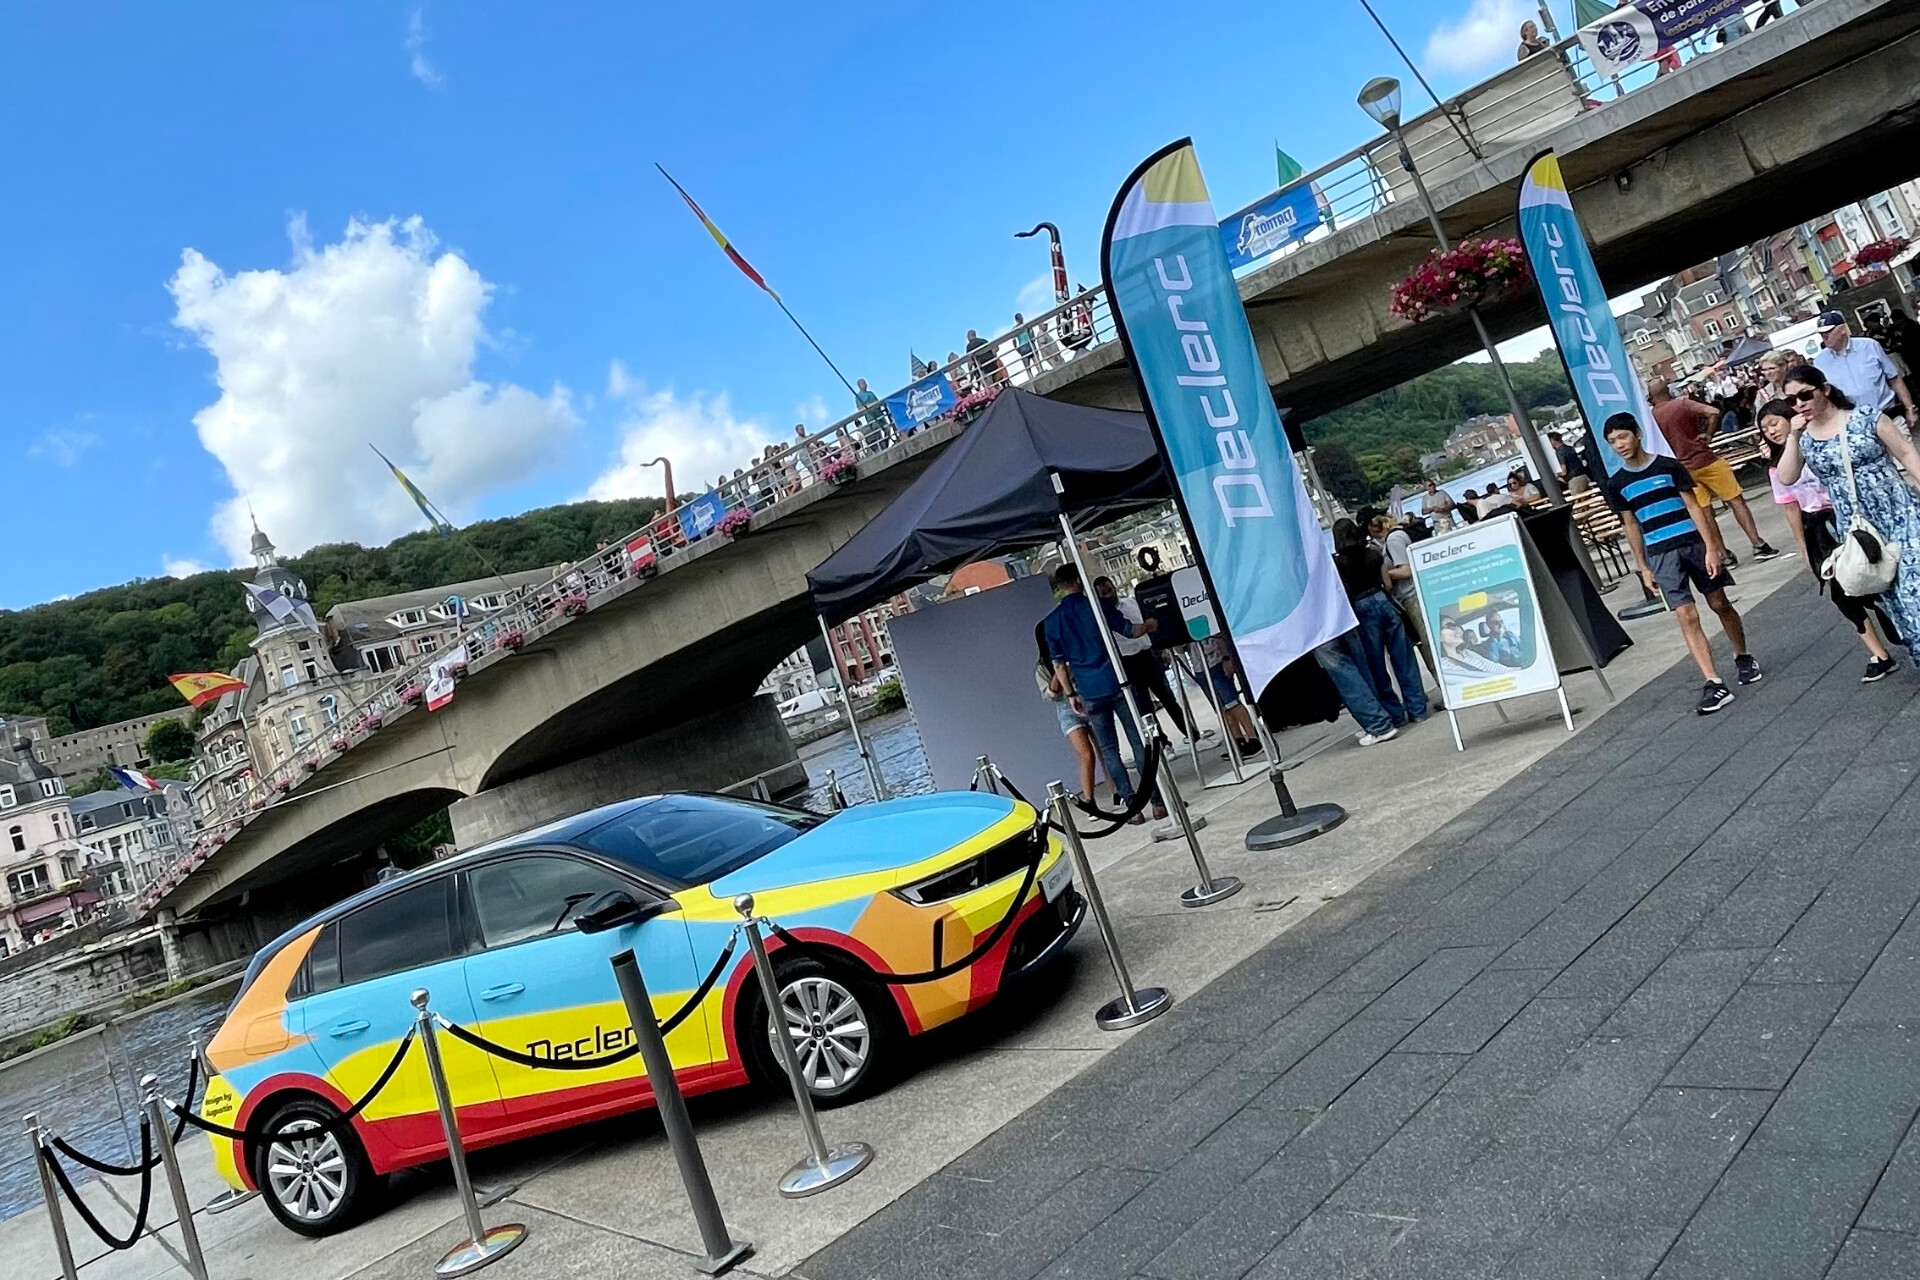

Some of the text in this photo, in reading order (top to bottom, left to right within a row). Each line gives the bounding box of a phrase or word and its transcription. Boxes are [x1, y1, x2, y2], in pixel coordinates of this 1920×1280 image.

[1660, 11, 1677, 23] de
[1255, 208, 1294, 237] CONTACT
[1541, 222, 1629, 407] Declerc
[1153, 253, 1275, 529] Declerc
[1421, 541, 1476, 564] Declerc
[1181, 590, 1209, 609] Decle
[526, 1019, 662, 1069] Decler
